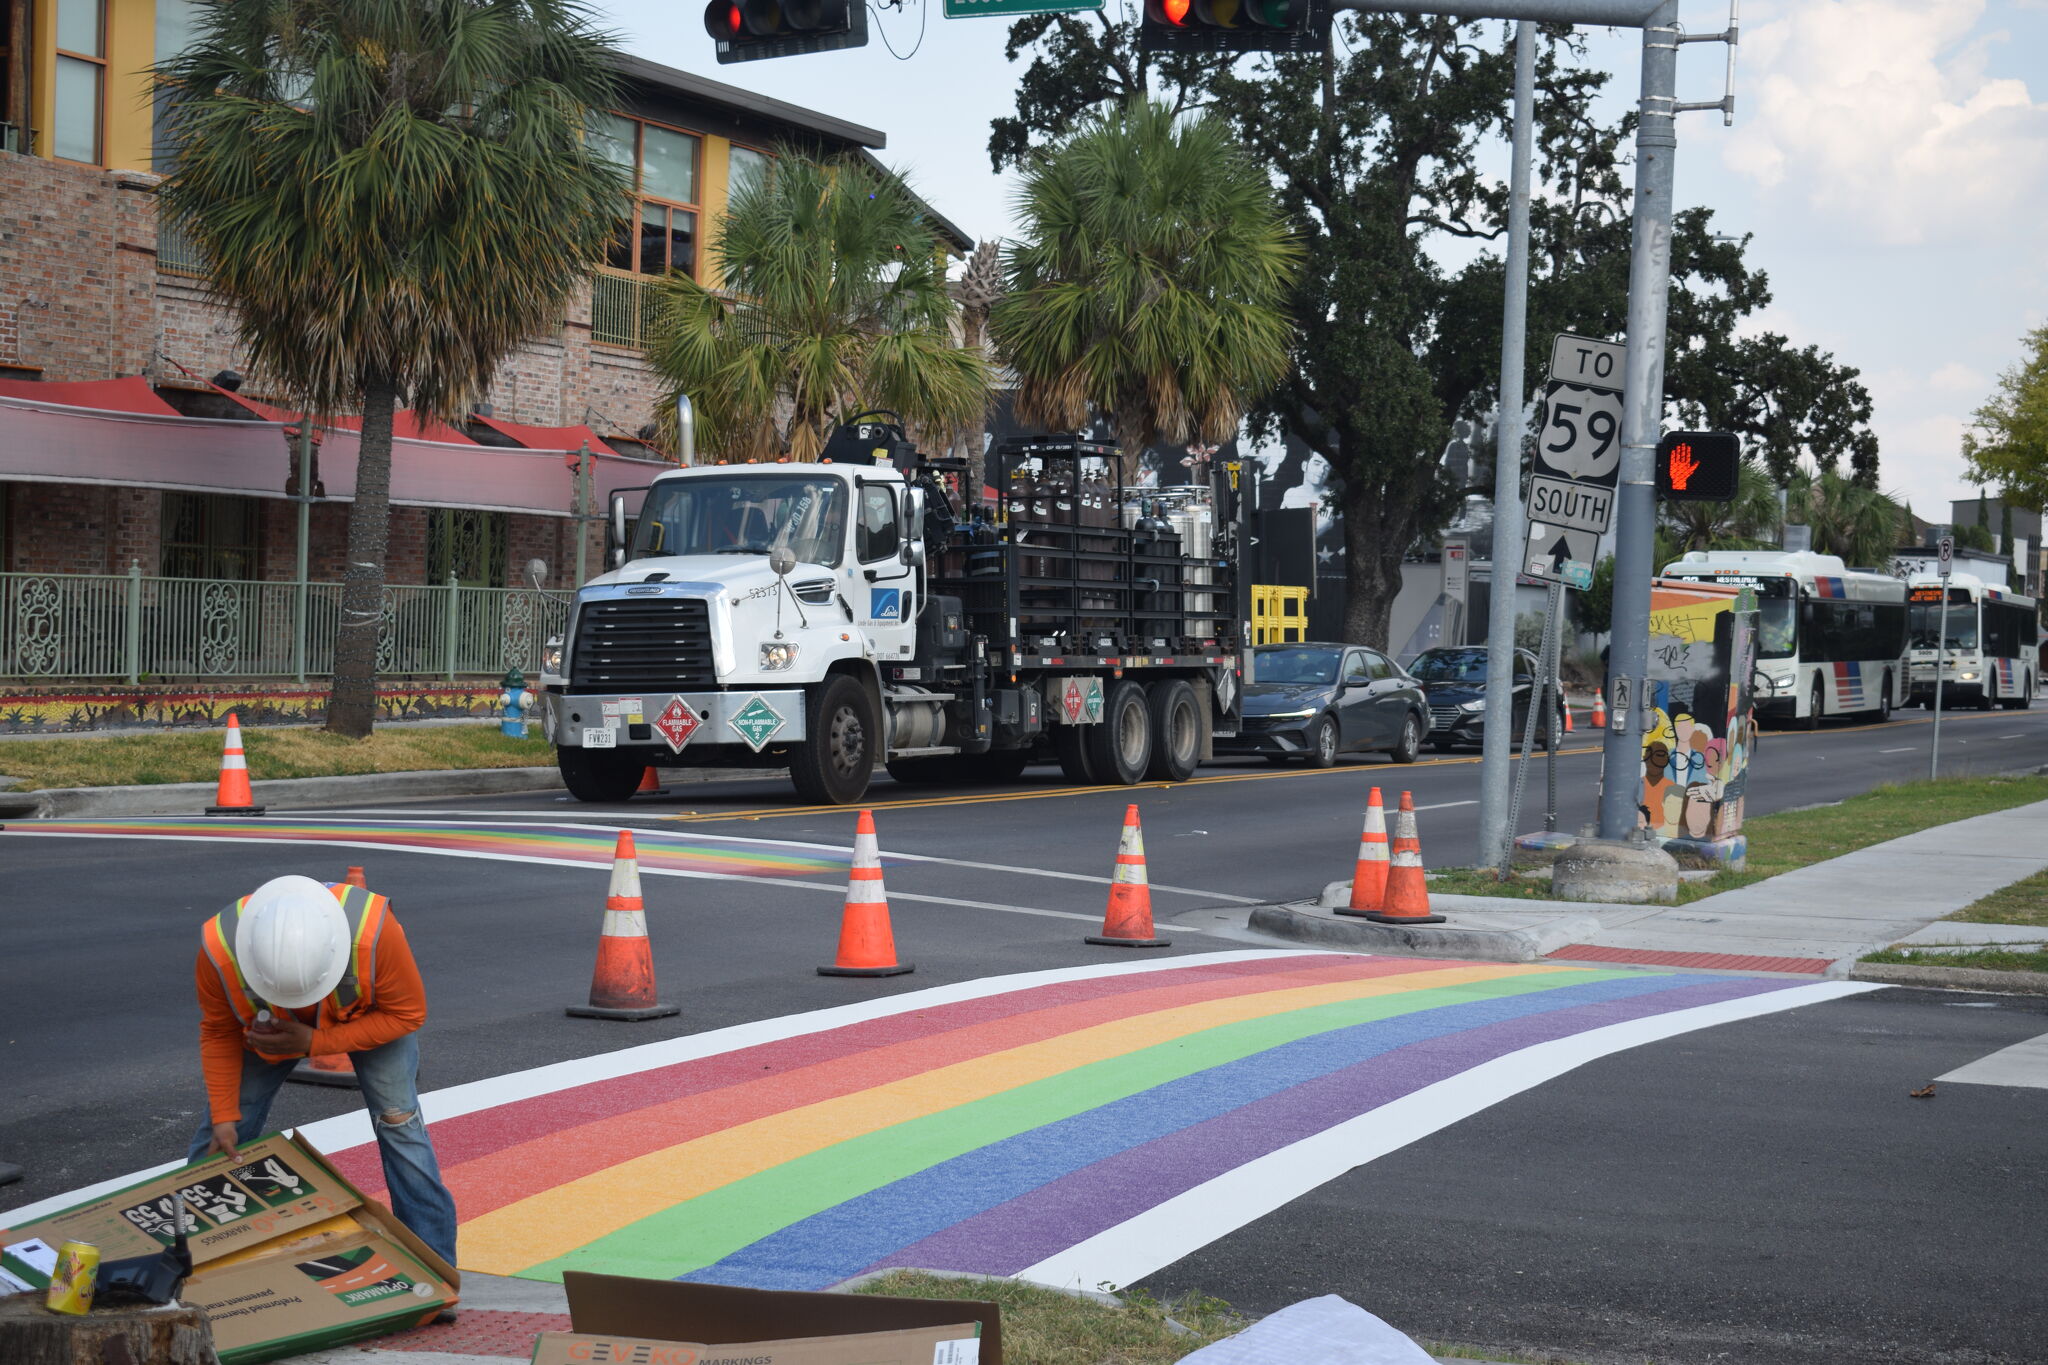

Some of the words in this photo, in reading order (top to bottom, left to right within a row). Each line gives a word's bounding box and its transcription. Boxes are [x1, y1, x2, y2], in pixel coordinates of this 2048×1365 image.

[1576, 348, 1613, 378] TO
[1547, 403, 1617, 461] 59
[1534, 486, 1606, 523] SOUTH
[738, 718, 777, 726] NON-FLAMMABLE
[201, 1223, 251, 1246] MARKINGS
[233, 1288, 275, 1305] pavement
[348, 1281, 411, 1304] OPTAMARK
[247, 1296, 303, 1317] Preformed
[567, 1341, 696, 1365] GEVEKO
[699, 1355, 772, 1365] MARKINGS
